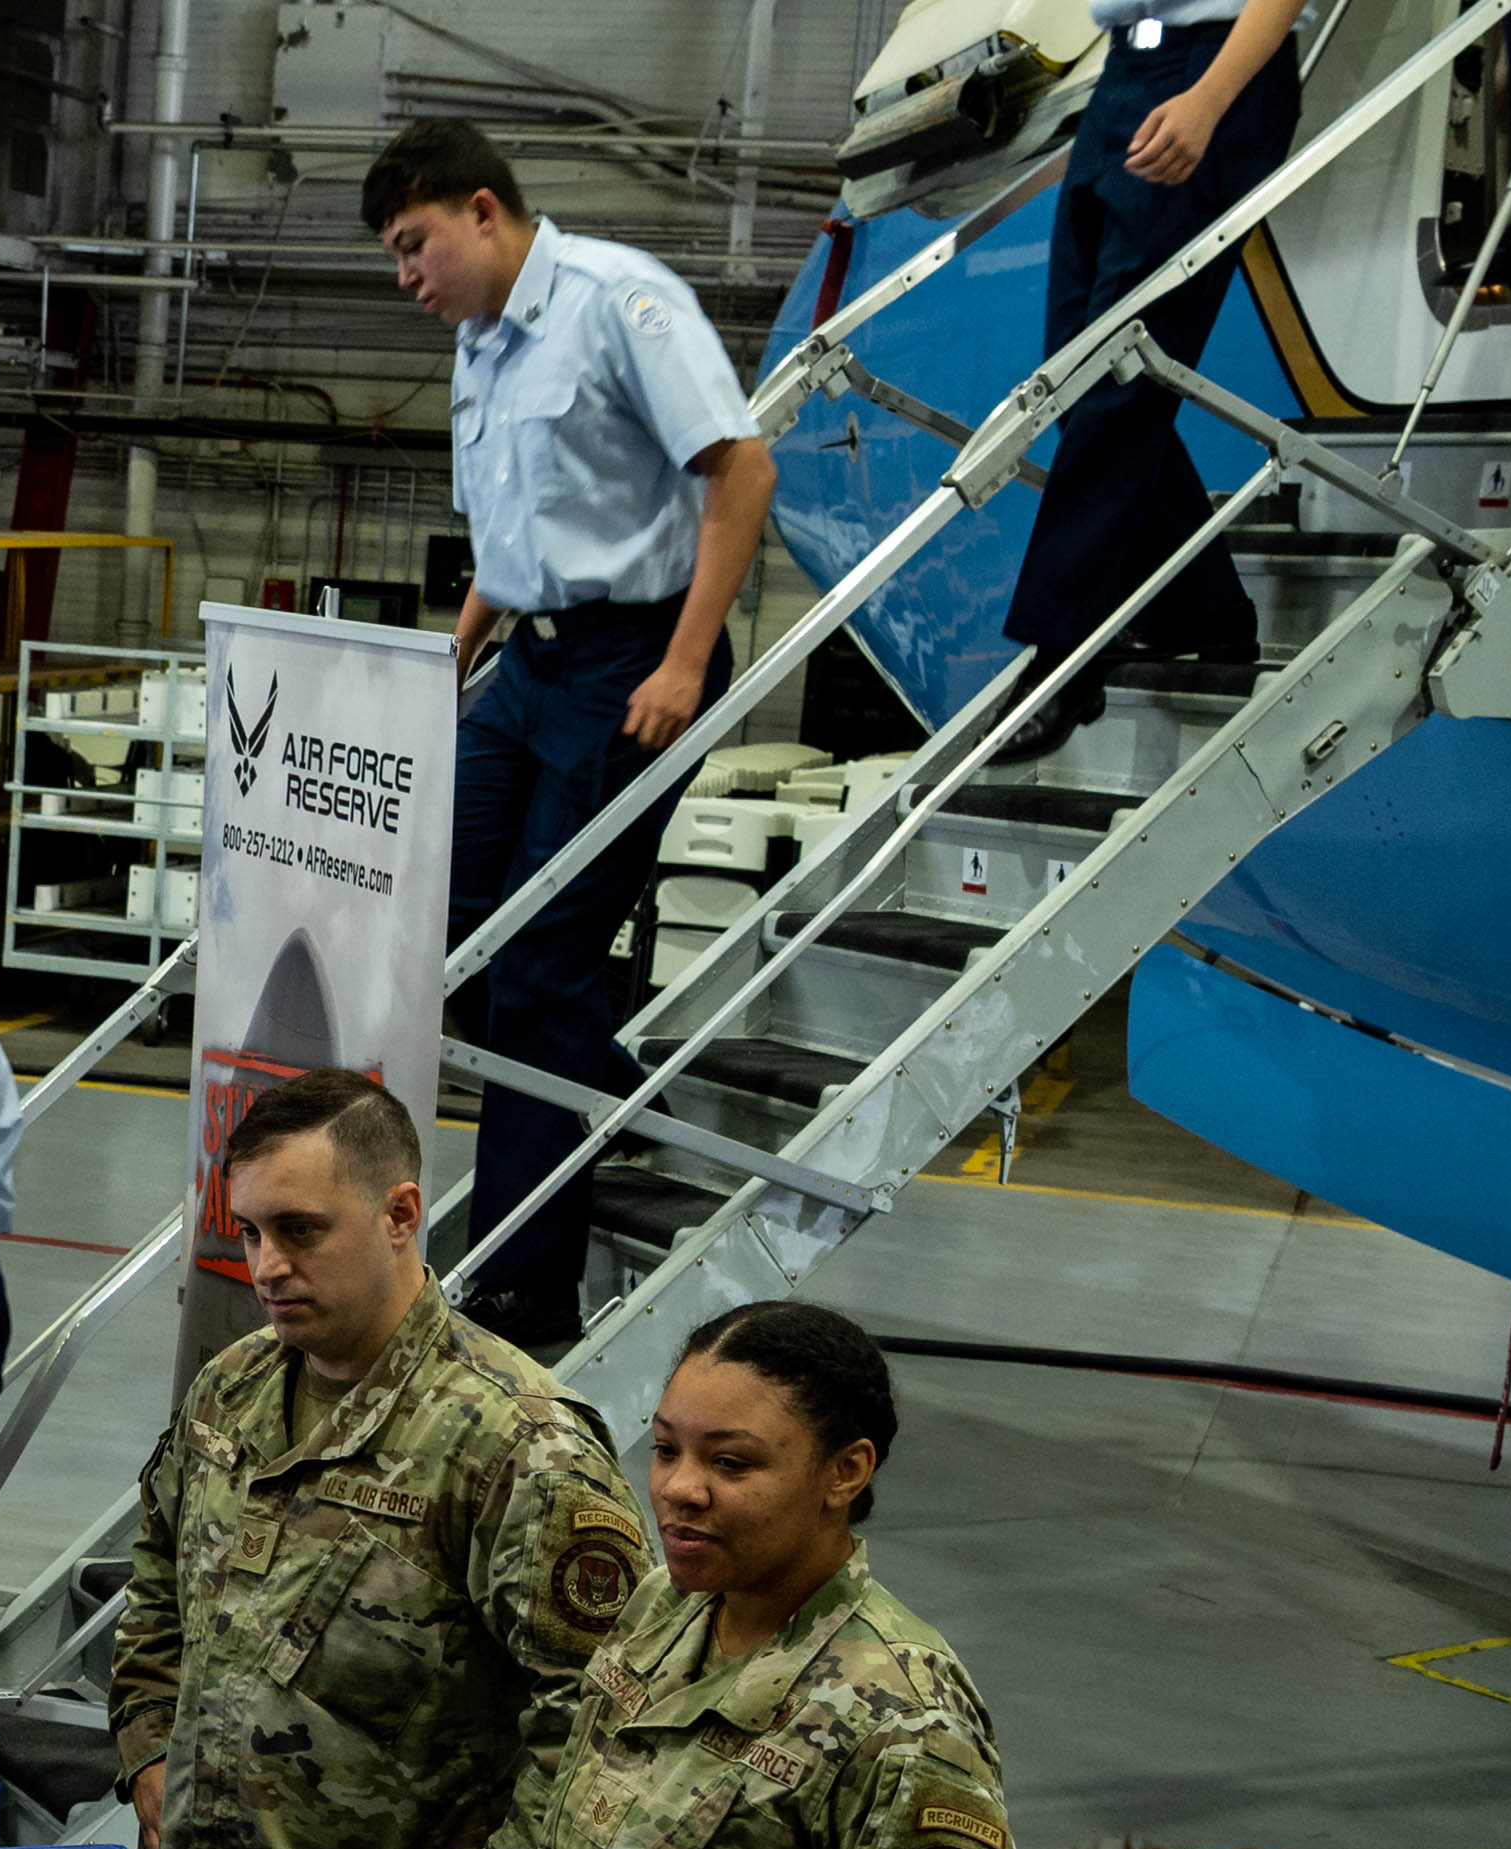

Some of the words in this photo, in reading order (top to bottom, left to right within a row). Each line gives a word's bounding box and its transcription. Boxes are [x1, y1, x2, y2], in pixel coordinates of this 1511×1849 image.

[281, 732, 324, 774] AIR
[328, 742, 413, 794] FORCE
[286, 773, 400, 834] RESERVE
[222, 823, 295, 867] 800-257-1212
[305, 845, 393, 896] AFReserve.com
[325, 1477, 347, 1498] U.S.
[352, 1483, 377, 1507] AIR
[378, 1489, 424, 1517] FORCE
[578, 1513, 638, 1538] RECRUITER
[927, 1810, 1001, 1843] RECRUITER
